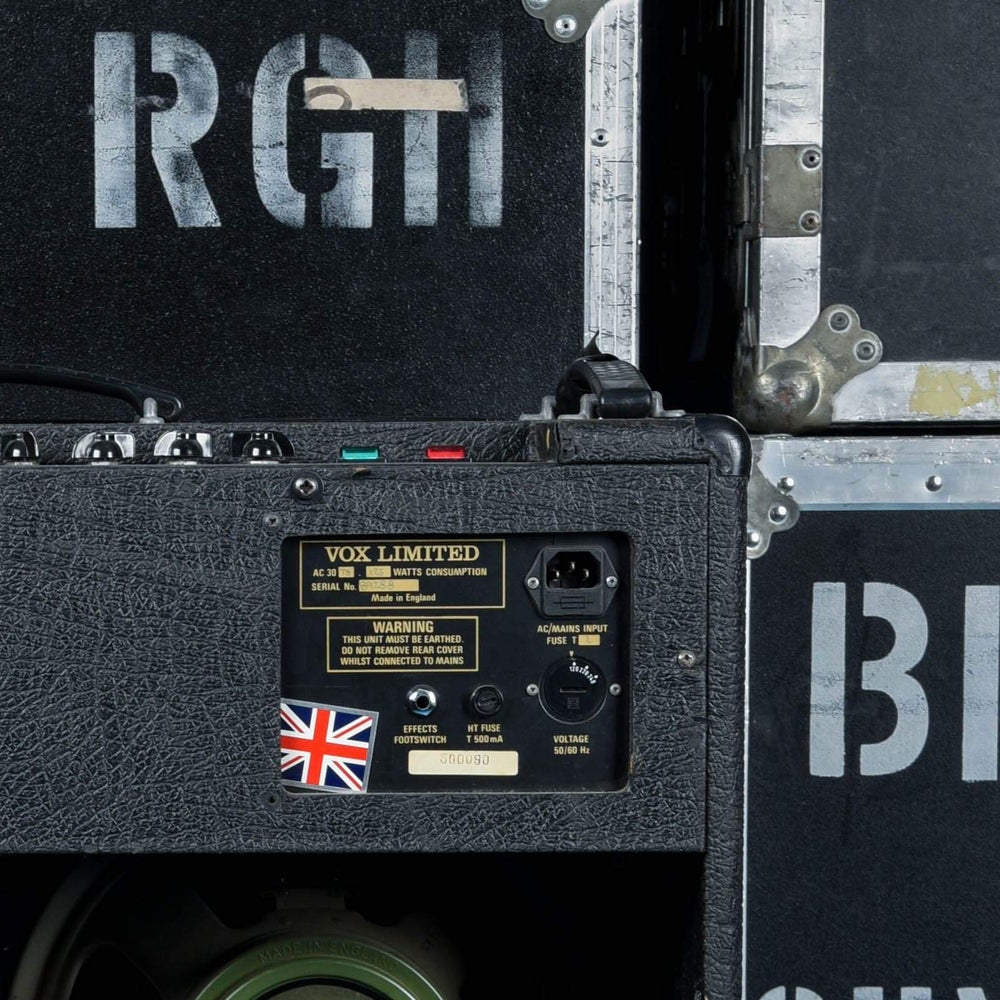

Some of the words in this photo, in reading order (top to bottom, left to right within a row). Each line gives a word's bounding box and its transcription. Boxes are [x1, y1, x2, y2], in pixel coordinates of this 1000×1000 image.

[325, 545, 372, 562] VOX
[377, 545, 480, 562] LIMITED
[312, 569, 326, 577] AC
[327, 569, 337, 577] 30
[393, 567, 422, 576] WATTS
[425, 567, 487, 577] CONSUMPTION
[311, 582, 340, 591] SERIAL
[343, 582, 357, 591] No.
[370, 593, 393, 602] Made
[395, 594, 403, 602] in
[405, 593, 436, 603] England
[373, 621, 434, 633] WARNING
[537, 622, 581, 635] AC/MAINS
[583, 624, 608, 633] INPUT
[342, 635, 361, 643] THIS
[364, 635, 383, 643] UNIT
[385, 635, 410, 643] MUST
[411, 635, 422, 643] BE
[424, 635, 464, 643] EARTHED.
[547, 636, 568, 645] FUSE
[572, 636, 577, 644] T
[341, 646, 353, 654] DO
[355, 646, 373, 654] NOT
[375, 645, 410, 654] REMOVE
[412, 645, 434, 654] REAR
[437, 645, 463, 654] COVER
[340, 657, 370, 665] WHILST
[373, 656, 421, 665] CONNECTED
[423, 656, 434, 665] TO
[435, 656, 464, 665] MAINS
[403, 724, 438, 733] EFFECTS
[467, 724, 479, 732] HT
[481, 724, 501, 732] FUSE
[394, 735, 447, 744] FOOTSWITCH
[466, 735, 471, 743] T
[553, 735, 590, 744] VOLTAGE
[553, 746, 578, 755] 50/60
[580, 746, 590, 754] Hz
